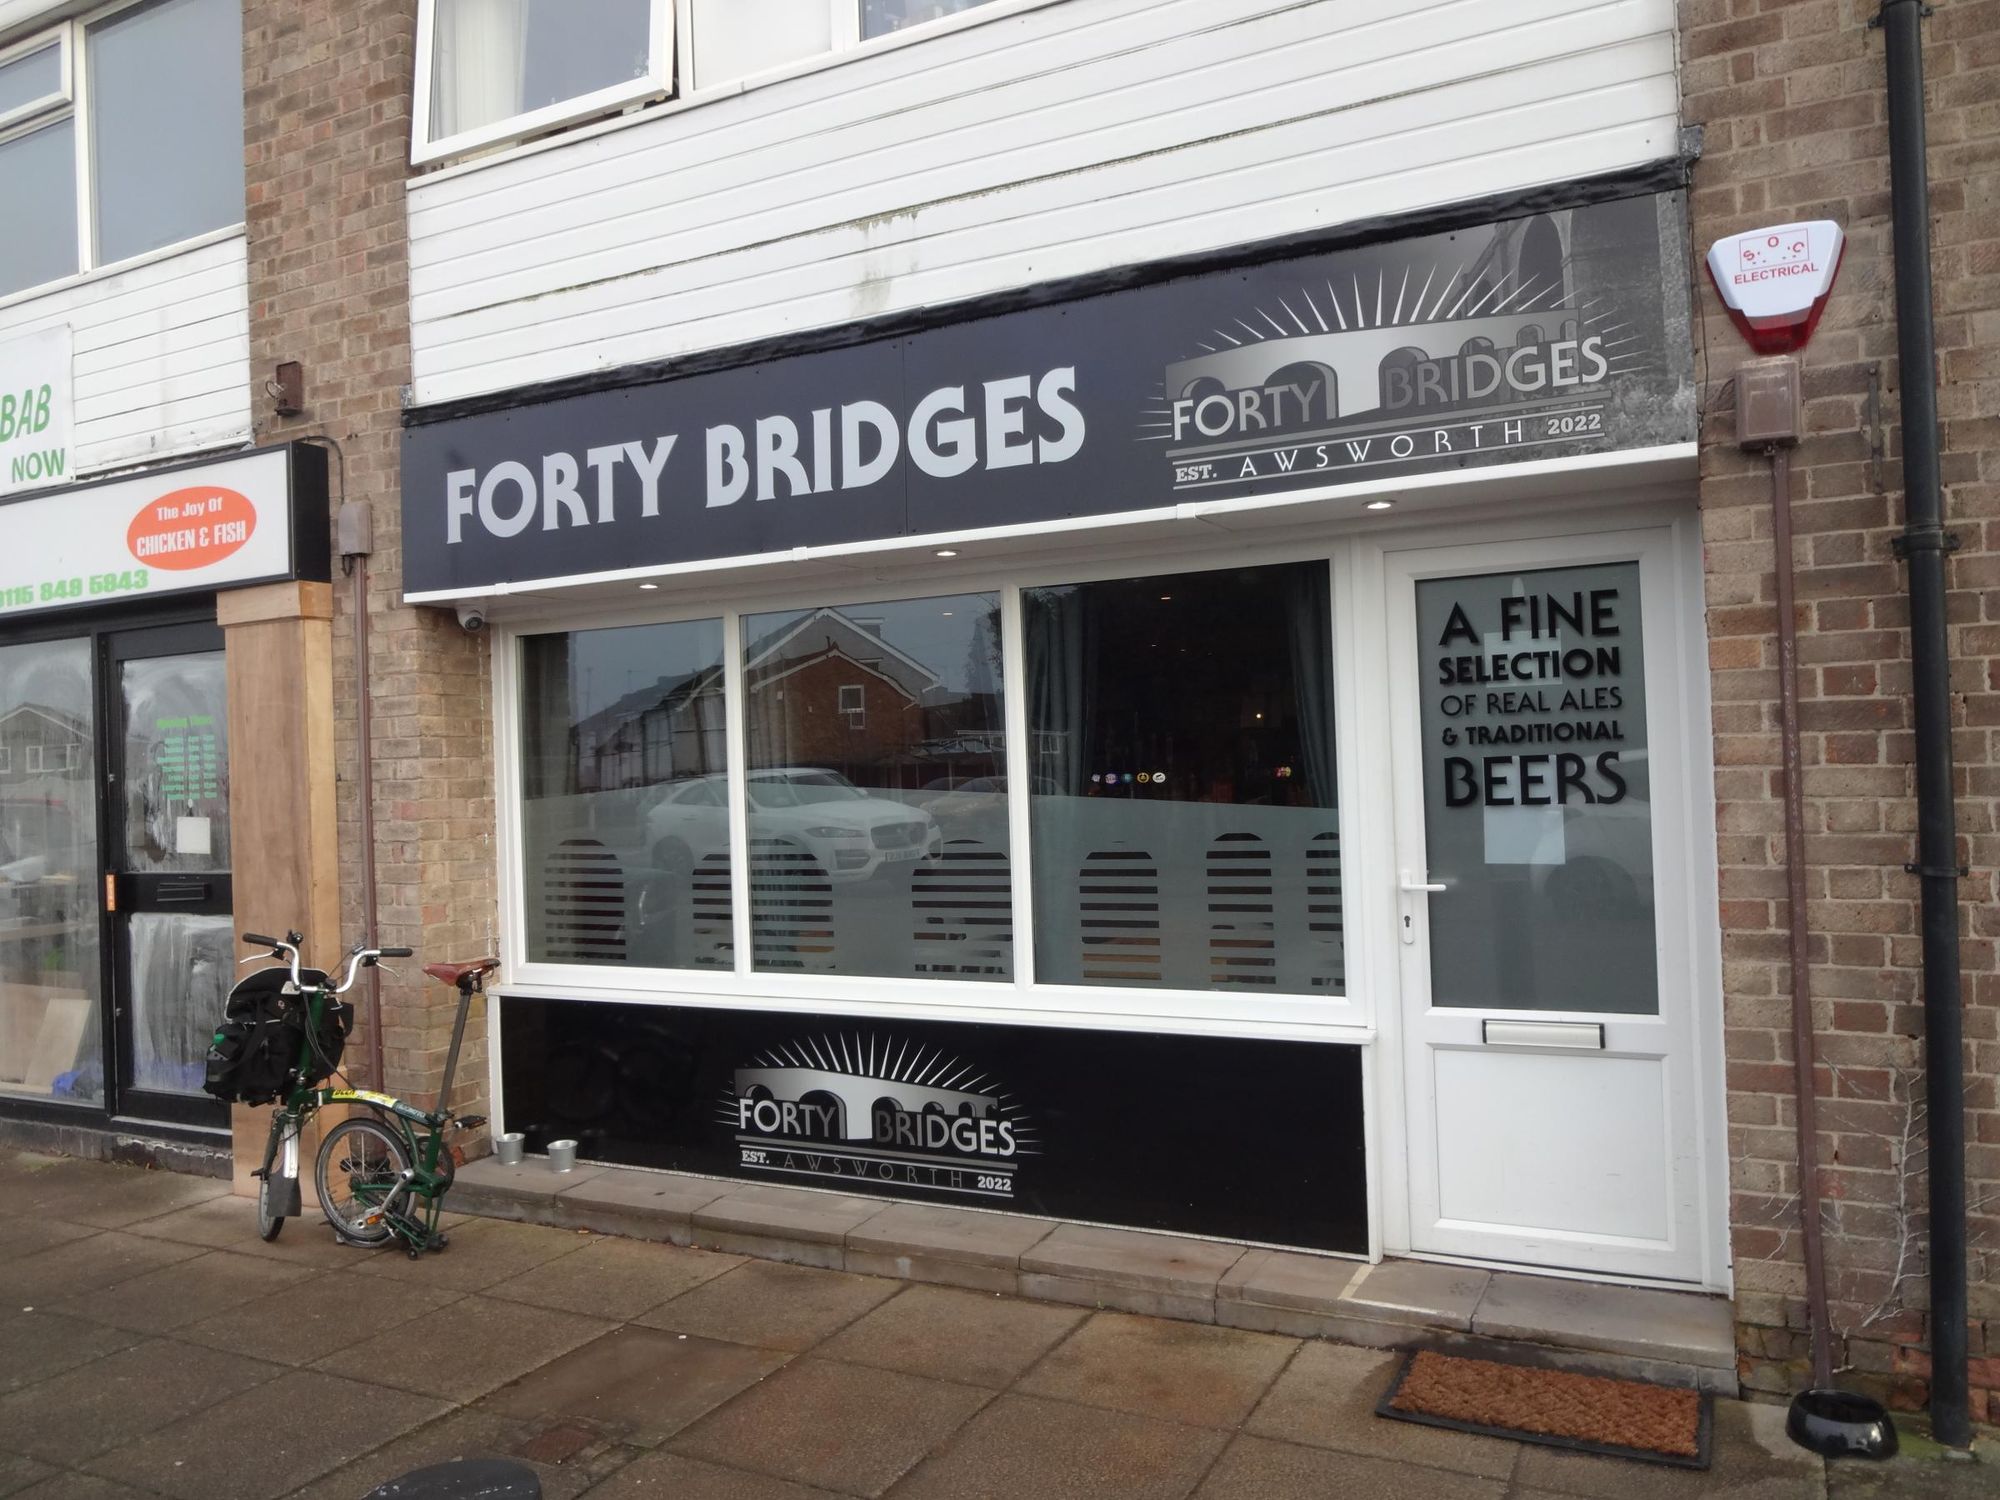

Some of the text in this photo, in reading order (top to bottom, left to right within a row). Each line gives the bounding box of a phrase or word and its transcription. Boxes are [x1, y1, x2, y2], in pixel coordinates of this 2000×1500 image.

[1734, 262, 1819, 285] ELECTRICAL
[1172, 335, 1609, 441] FORTY BRIDGES
[12, 448, 65, 483] NOW
[446, 366, 1086, 544] FORTY BRIDGES
[1175, 413, 1602, 483] EST. AWSWORTH 2022
[157, 497, 223, 520] The Joy Of
[136, 520, 246, 556] CHICKEN & FISH
[1438, 588, 1620, 645] A FINE
[1438, 646, 1621, 685] SELECTION
[1440, 686, 1623, 716] OF REAL ALES
[1442, 720, 1624, 746] & TRADITIONAL
[1444, 751, 1628, 807] BEERS
[738, 1098, 1016, 1156] FORTY BRIDGES
[742, 1149, 1012, 1191] EST. AWSWORTH 2022
